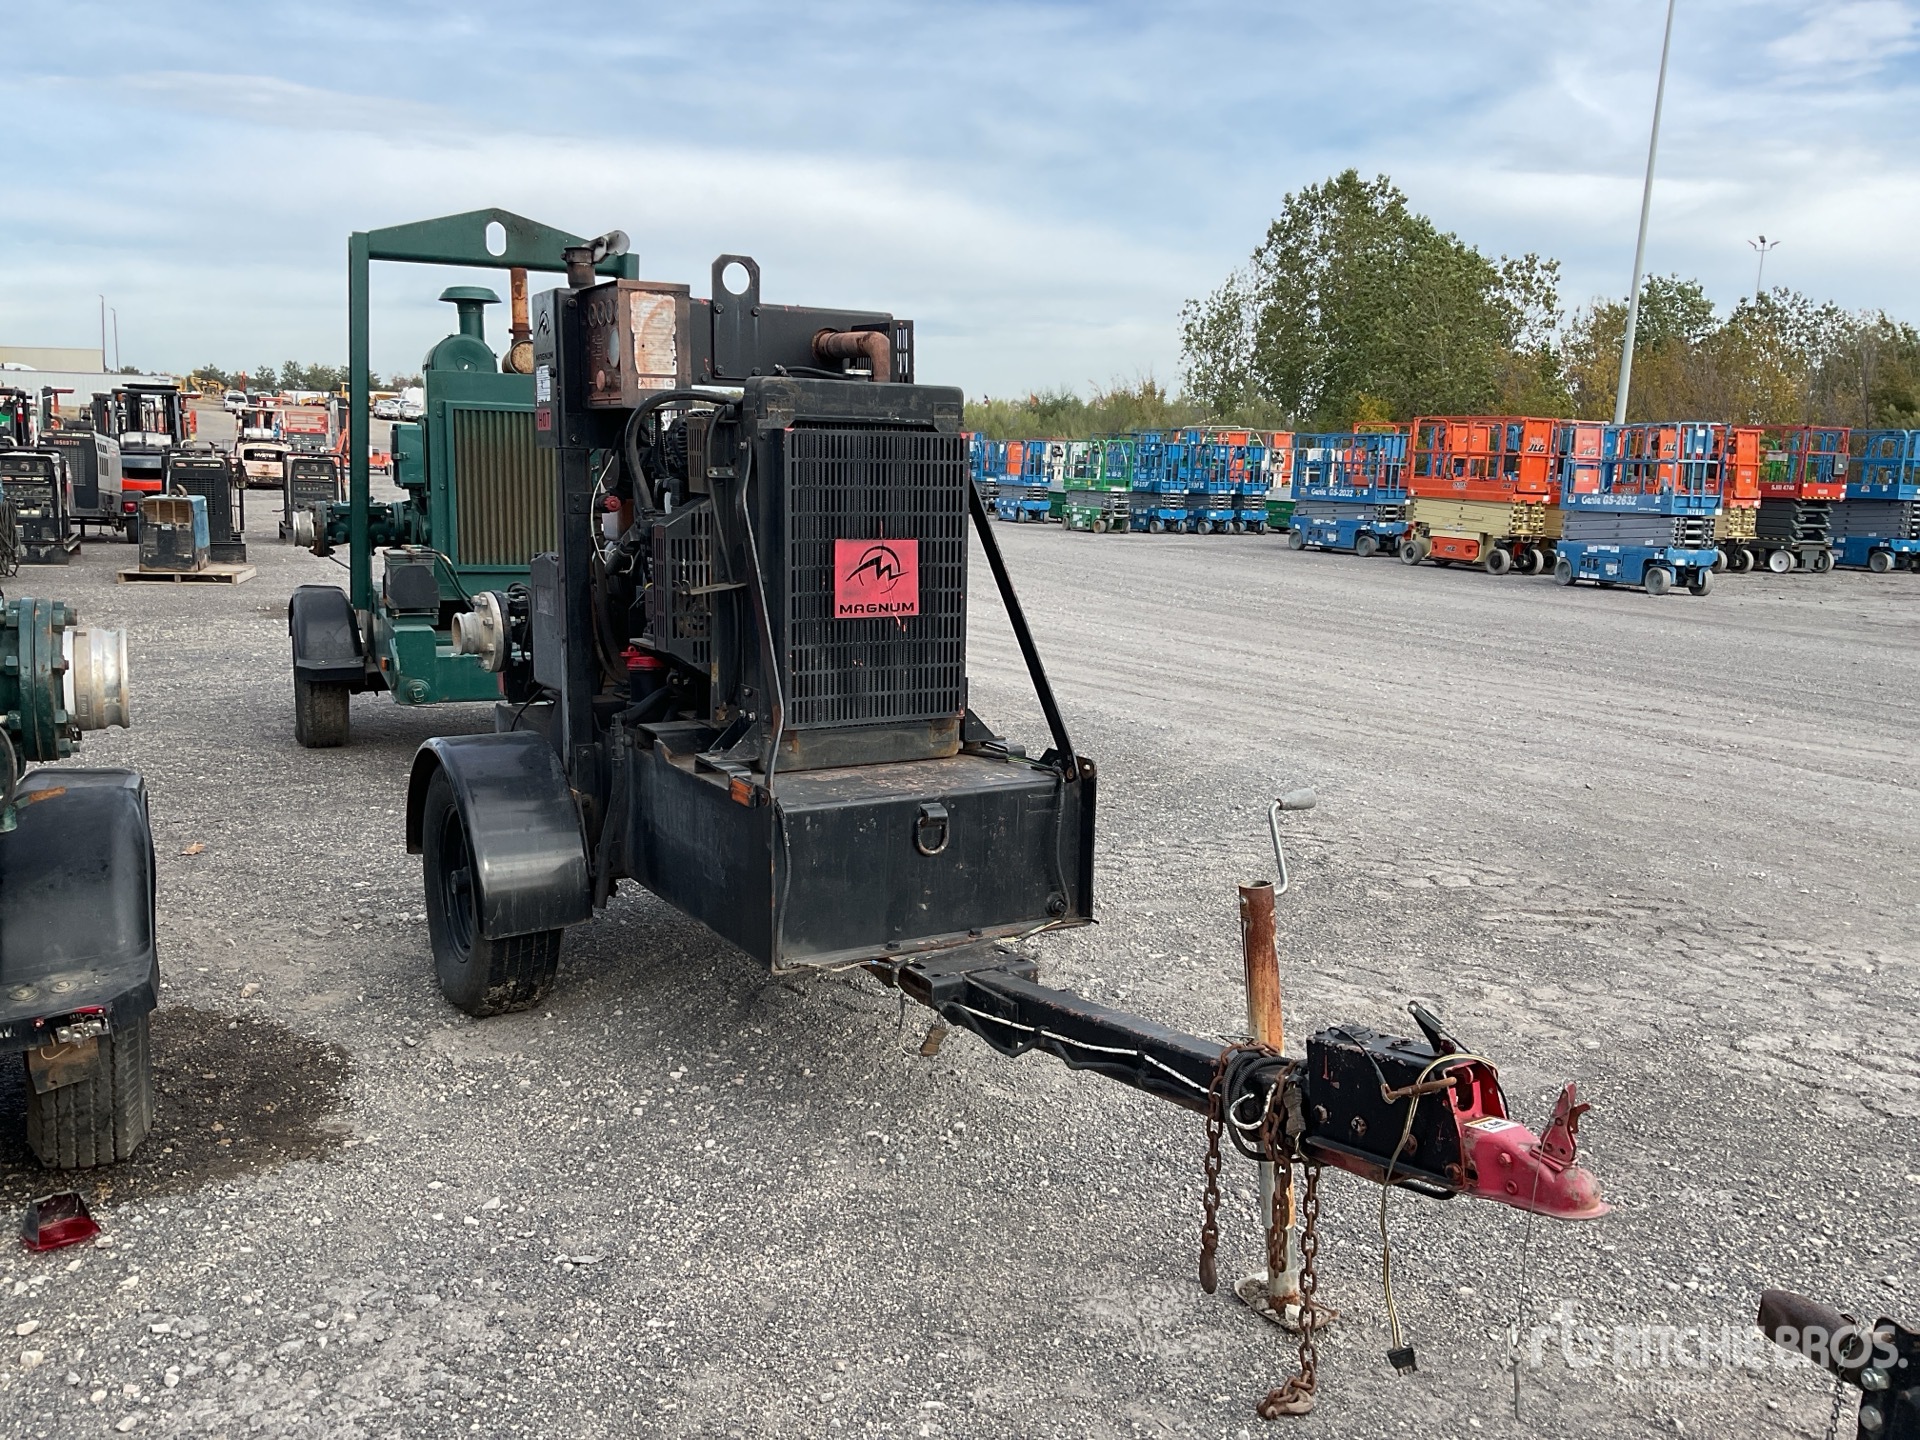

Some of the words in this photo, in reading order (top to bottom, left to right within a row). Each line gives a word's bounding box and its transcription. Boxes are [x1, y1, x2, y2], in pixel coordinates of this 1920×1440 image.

[536, 351, 554, 361] MAGNUM
[539, 411, 551, 428] HOT
[1528, 444, 1545, 452] JLG
[1311, 487, 1327, 497] Genie
[1329, 487, 1354, 498] GS-2032
[1581, 495, 1602, 505] Genie
[1603, 495, 1637, 506] GS-2632
[839, 602, 915, 615] MAGNUM
